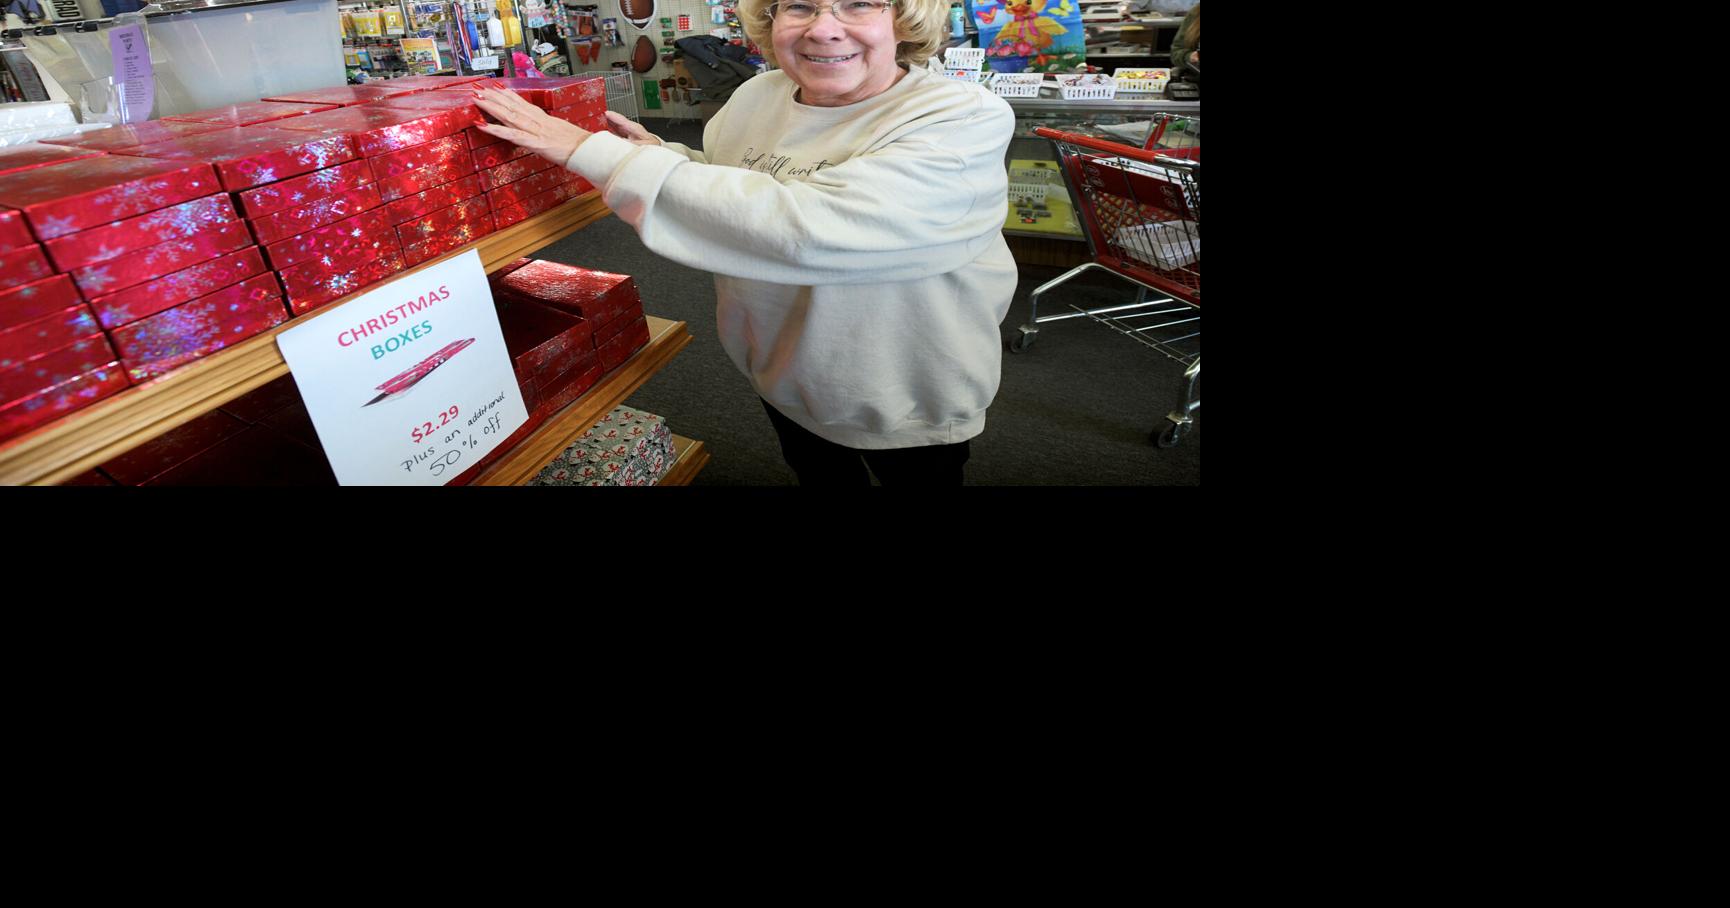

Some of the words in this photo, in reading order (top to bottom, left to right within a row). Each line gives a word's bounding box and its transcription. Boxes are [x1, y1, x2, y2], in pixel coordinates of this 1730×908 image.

[337, 285, 450, 347] CHRISTMAS
[370, 319, 433, 360] BOXES
[411, 405, 459, 443] $2.29
[444, 429, 461, 443] an
[483, 411, 501, 434] off
